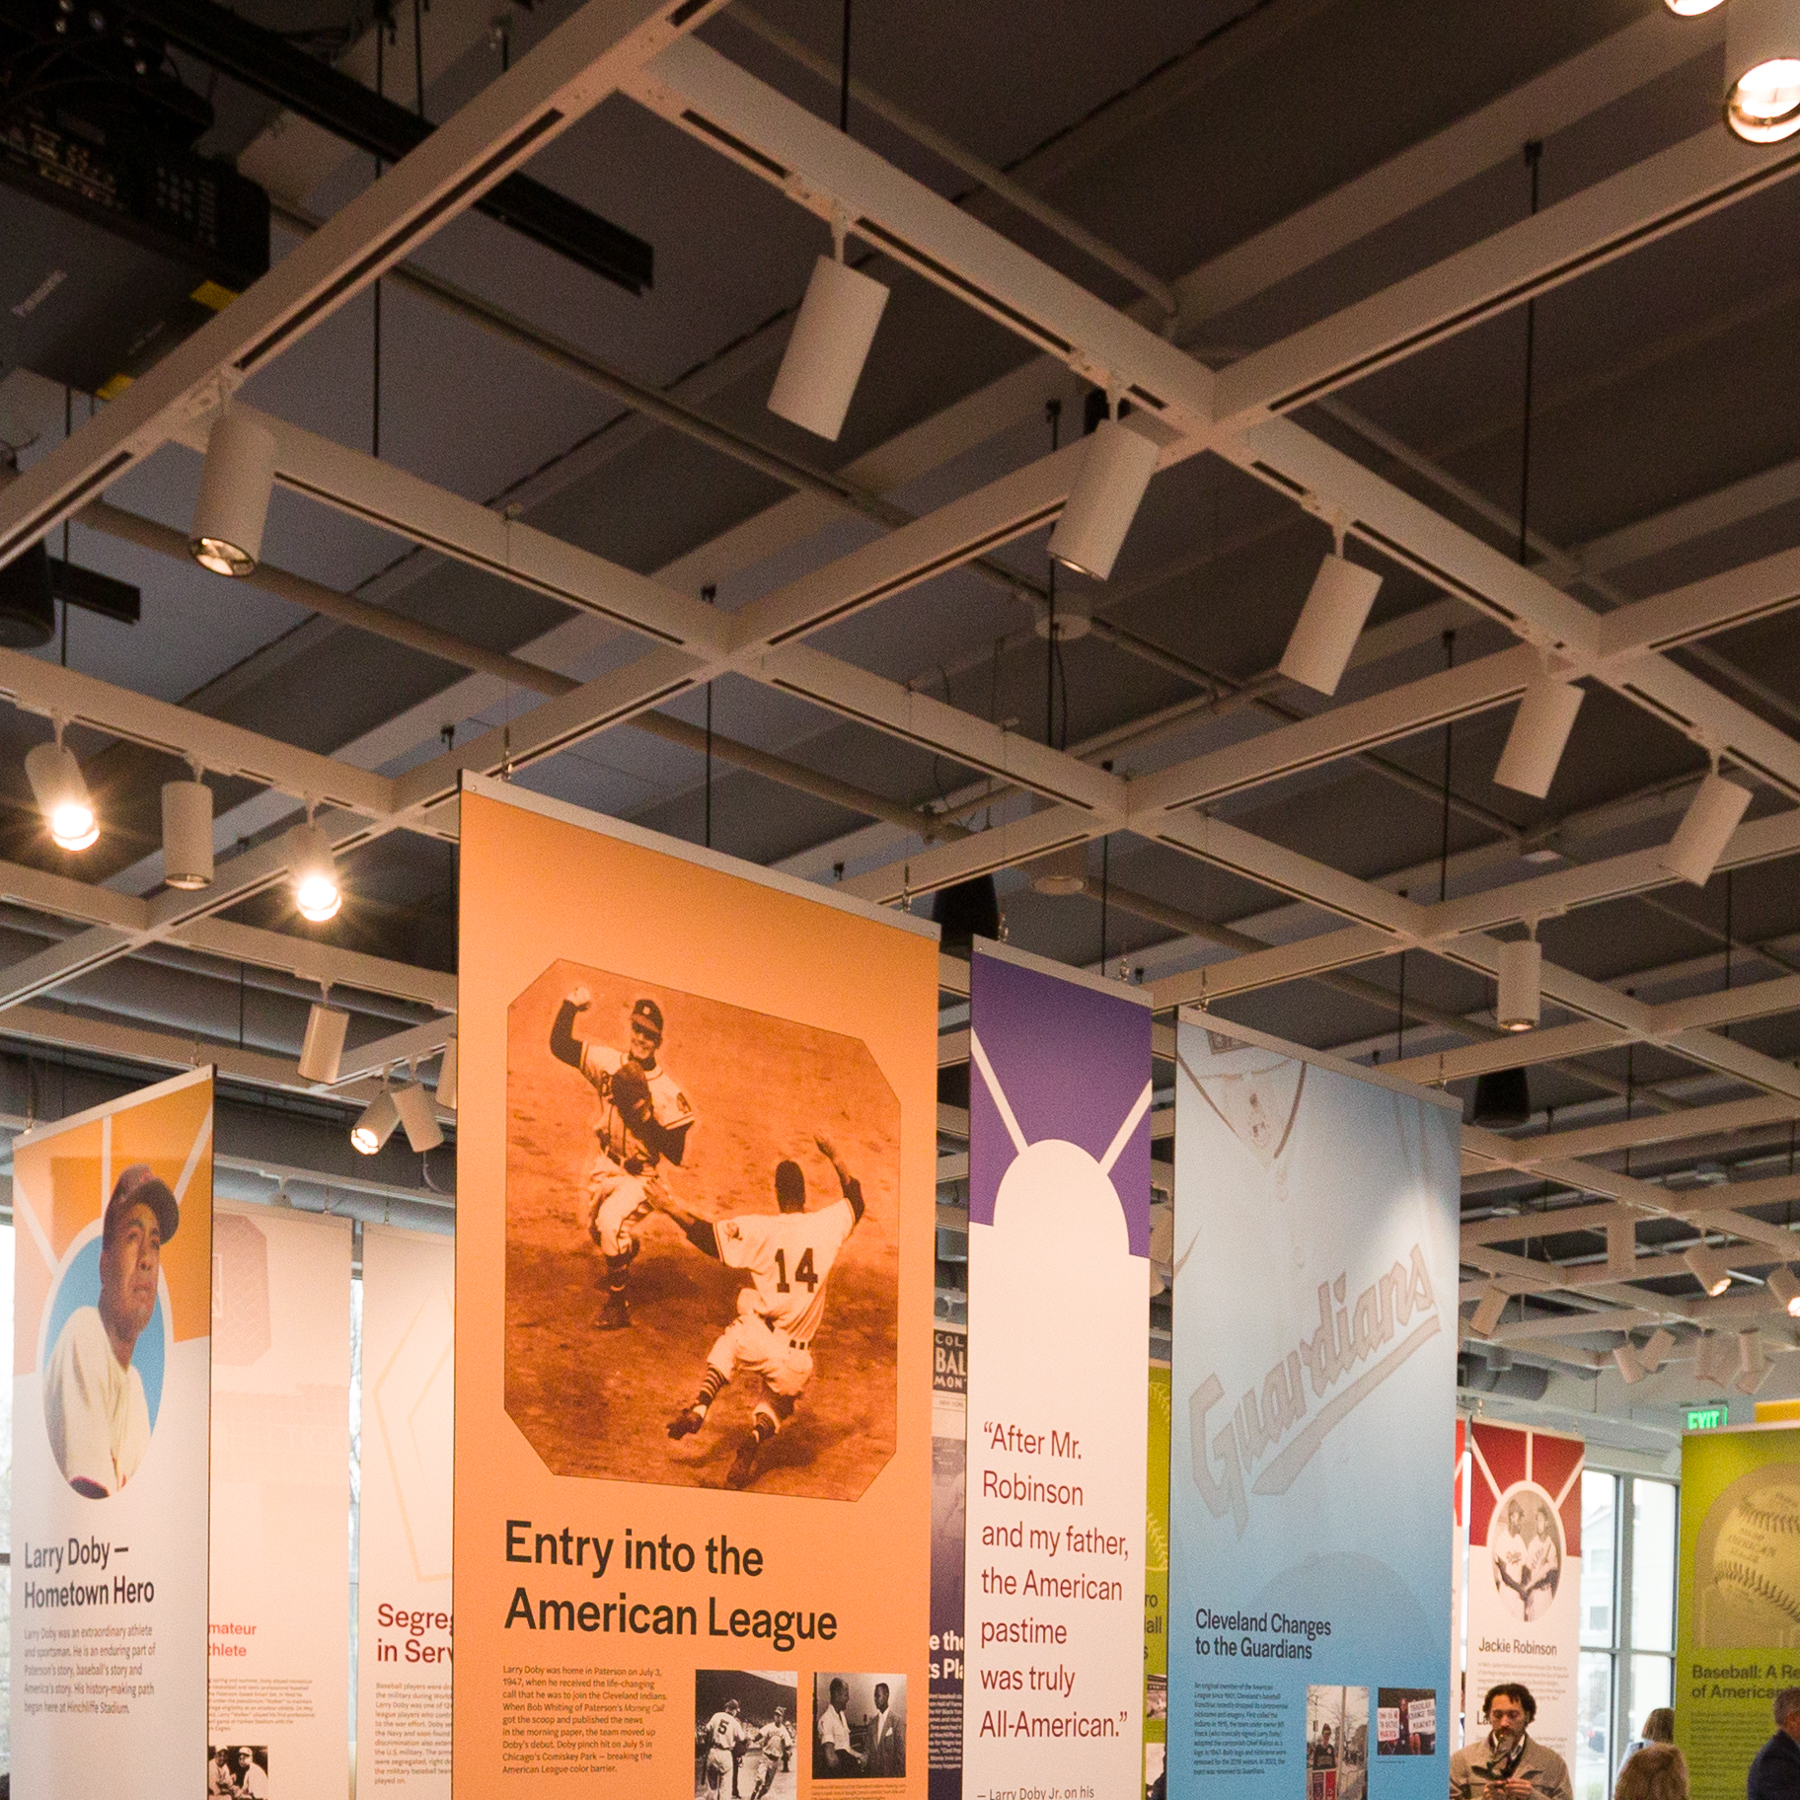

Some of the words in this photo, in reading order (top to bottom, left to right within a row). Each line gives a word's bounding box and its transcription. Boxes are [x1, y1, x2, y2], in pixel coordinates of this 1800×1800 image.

[775, 1247, 818, 1293] 14
[935, 1333, 964, 1347] COL
[935, 1347, 966, 1376] BAL
[934, 1375, 966, 1388] MON
[1189, 1243, 1439, 1541] Guardians
[1688, 1410, 1720, 1430] EXIT
[1051, 1430, 1082, 1459] Mr.
[982, 1470, 1084, 1506] Robinson
[25, 1542, 63, 1574] Larry
[69, 1536, 110, 1570] Doby
[506, 1520, 614, 1579] Entry
[625, 1528, 695, 1572] into
[705, 1535, 763, 1576] the
[982, 1522, 1022, 1548] and
[1029, 1527, 1060, 1557] my
[1066, 1526, 1129, 1561] father,
[25, 1581, 108, 1609] Hometown
[114, 1575, 154, 1604] Hero
[981, 1568, 1017, 1595] the
[1023, 1569, 1122, 1601] American
[209, 1622, 257, 1635] mateur
[504, 1587, 697, 1635] American
[709, 1597, 837, 1652] League
[981, 1618, 1068, 1648] pastime
[1196, 1609, 1268, 1632] Cleveland
[1271, 1613, 1331, 1641] Changes
[208, 1643, 247, 1656] thlete
[377, 1639, 398, 1662] in
[1196, 1636, 1210, 1655] to
[1214, 1636, 1237, 1656] the
[1241, 1638, 1312, 1660] Guardians
[1479, 1638, 1511, 1653] Jackie
[1513, 1640, 1557, 1655] Robinson
[503, 1666, 522, 1675] Larry
[525, 1666, 544, 1675] Doby
[563, 1667, 583, 1675] home
[639, 1669, 654, 1677] July
[655, 1669, 662, 1677] 3,
[981, 1665, 1023, 1689] was
[1029, 1664, 1075, 1697] truly
[1692, 1665, 1761, 1679] Baseball:
[1766, 1665, 1777, 1678] A
[718, 1719, 729, 1735] 5
[541, 1766, 568, 1775] League
[1049, 1788, 1061, 1799] Jr.
[1065, 1789, 1077, 1799] on
[1080, 1786, 1094, 1798] his
